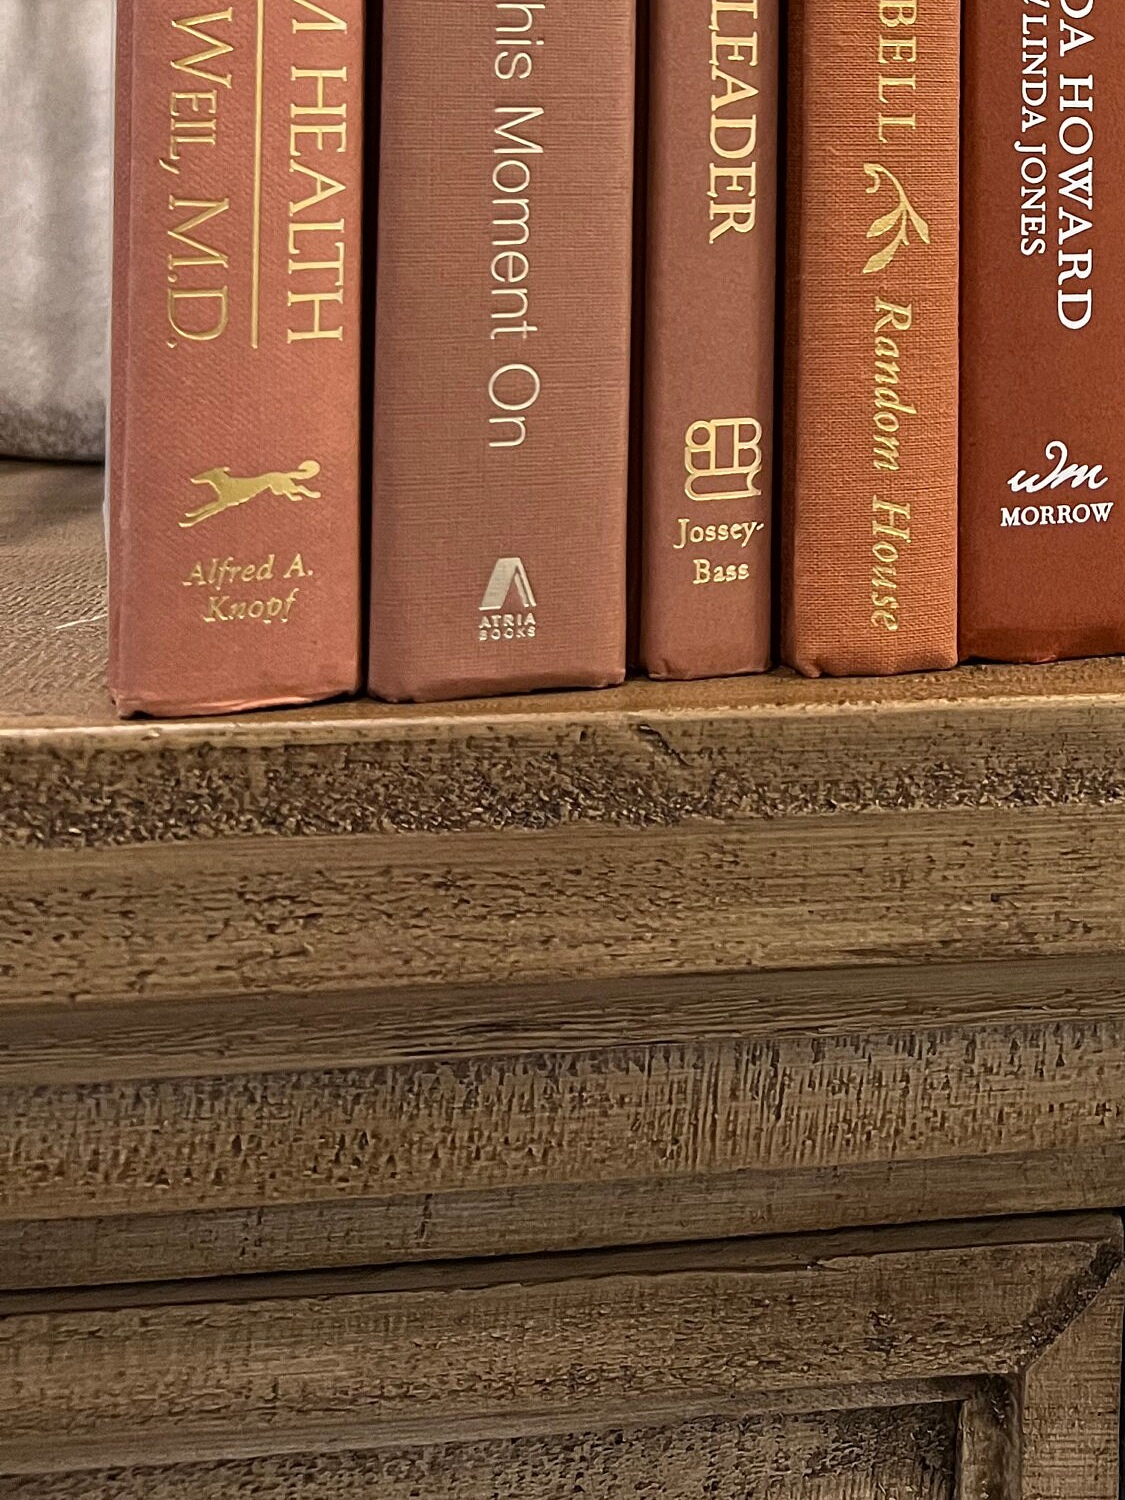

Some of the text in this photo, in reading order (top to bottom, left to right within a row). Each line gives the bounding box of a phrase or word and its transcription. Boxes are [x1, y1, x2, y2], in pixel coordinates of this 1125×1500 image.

[1020, 13, 1049, 134] LINDA
[287, 66, 349, 344] HEALTH
[490, 106, 543, 341] Moment
[1013, 142, 1047, 257] JONES
[1056, 75, 1094, 331] HOWARD
[166, 195, 229, 350] M.D.
[487, 367, 541, 449] On
[869, 296, 913, 632] Random House
[673, 518, 764, 549] Jossey-
[1000, 502, 1114, 528] MORROW
[182, 553, 313, 590] Alfred A.
[203, 588, 299, 623] Knopf
[692, 558, 750, 585] Bass
[478, 612, 536, 629] ATRIA
[479, 626, 536, 641] BOOKS
